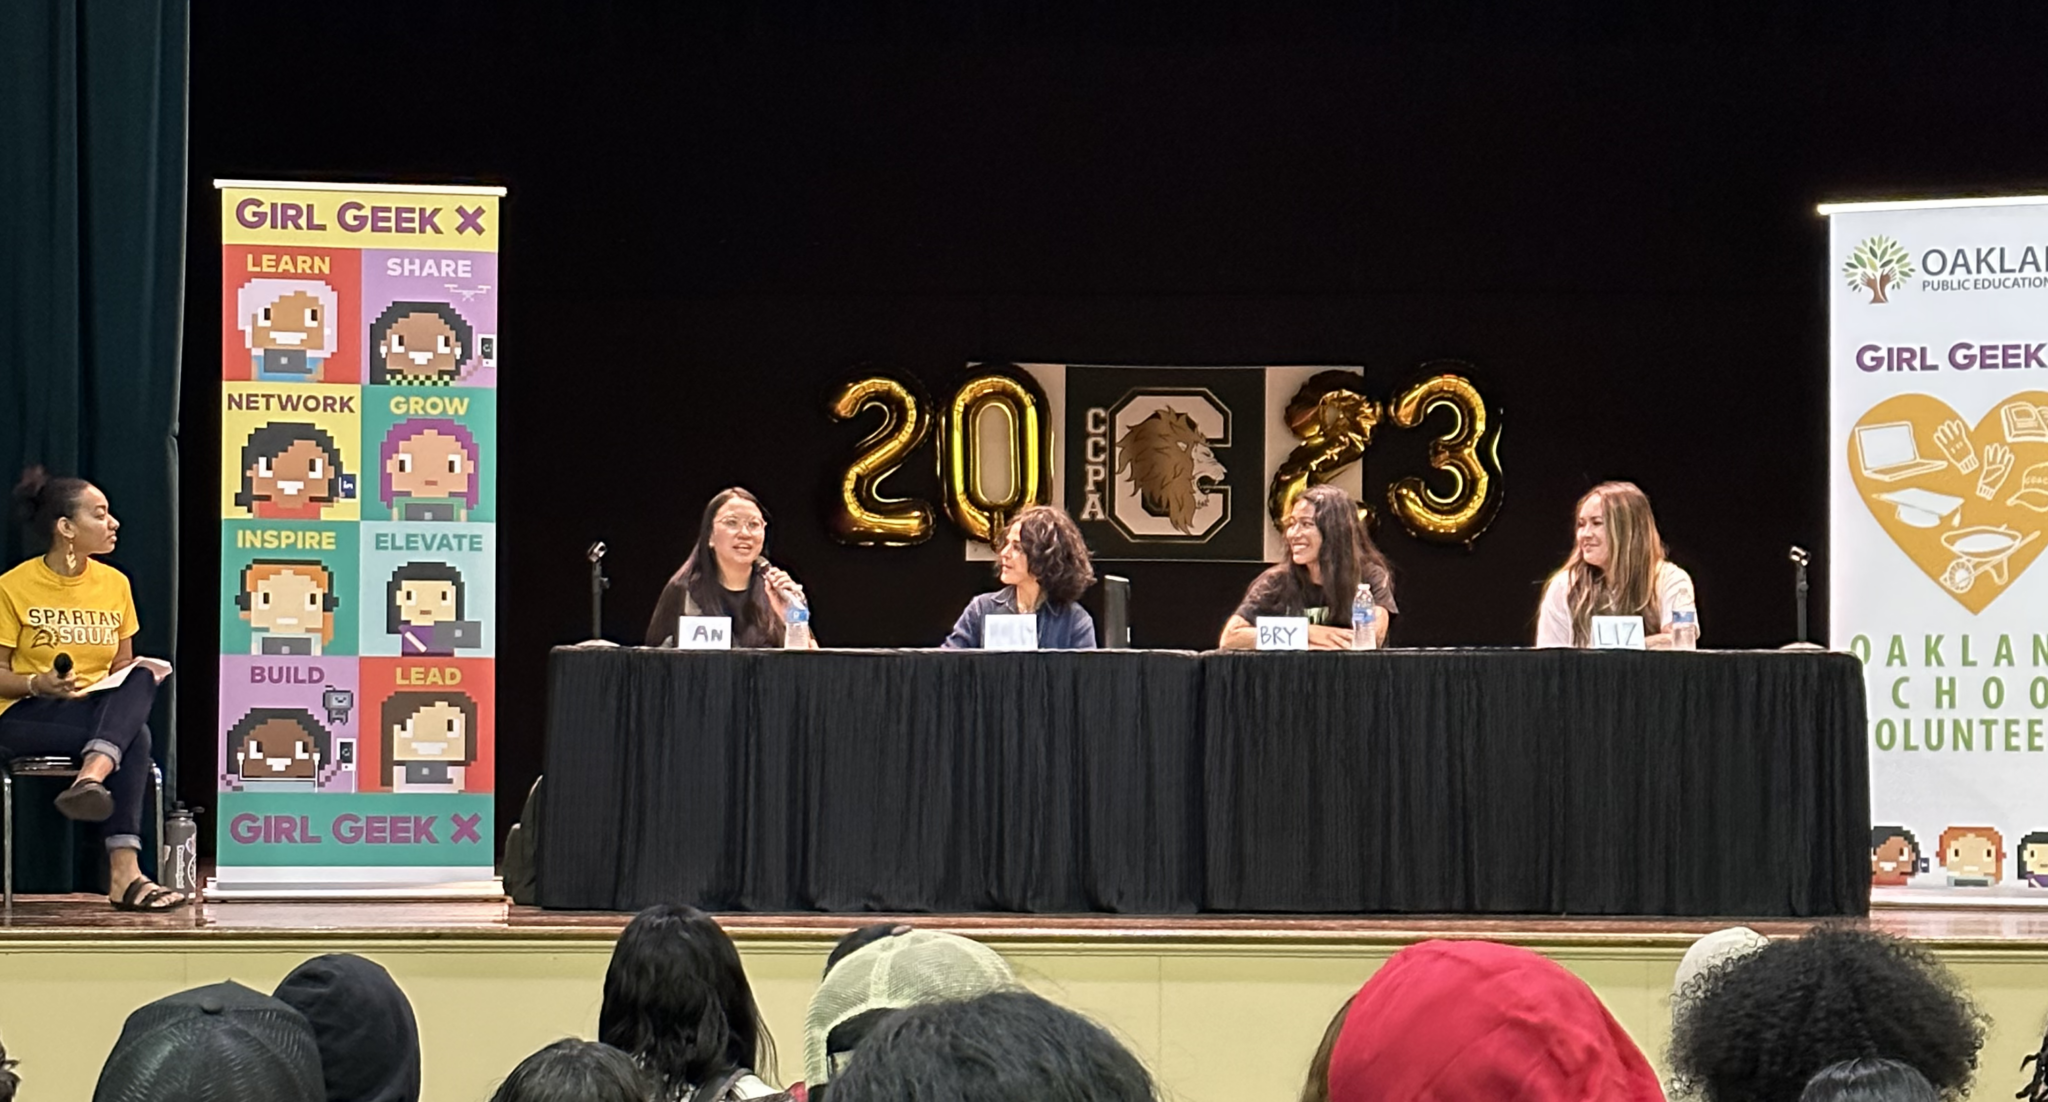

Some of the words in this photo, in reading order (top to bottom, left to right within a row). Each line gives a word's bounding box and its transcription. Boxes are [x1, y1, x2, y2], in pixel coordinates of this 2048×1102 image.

[235, 198, 327, 231] GIRL
[336, 201, 444, 235] GEEK
[454, 205, 486, 236] X
[246, 253, 331, 275] LEARN
[386, 257, 472, 278] SHARE
[1922, 279, 1970, 292] PUBLIC
[1856, 344, 1939, 372] GIRL
[1948, 342, 2048, 371] GEEK
[227, 392, 356, 414] NETWORK
[389, 395, 470, 416] GROW
[1081, 407, 1106, 521] CCPA
[236, 529, 337, 551] INSPIRE
[374, 532, 483, 552] ELEVATE
[29, 608, 121, 627] SPARTAN
[60, 626, 119, 645] SQUA
[1260, 625, 1298, 646] BRY
[1597, 621, 1639, 646] LIZ
[249, 665, 325, 685] BUILD
[395, 667, 462, 686] LEAD
[1872, 718, 2044, 751] OLUNTEE
[229, 813, 322, 845] GIRL
[331, 813, 439, 845] GEEK
[450, 812, 483, 845] X
